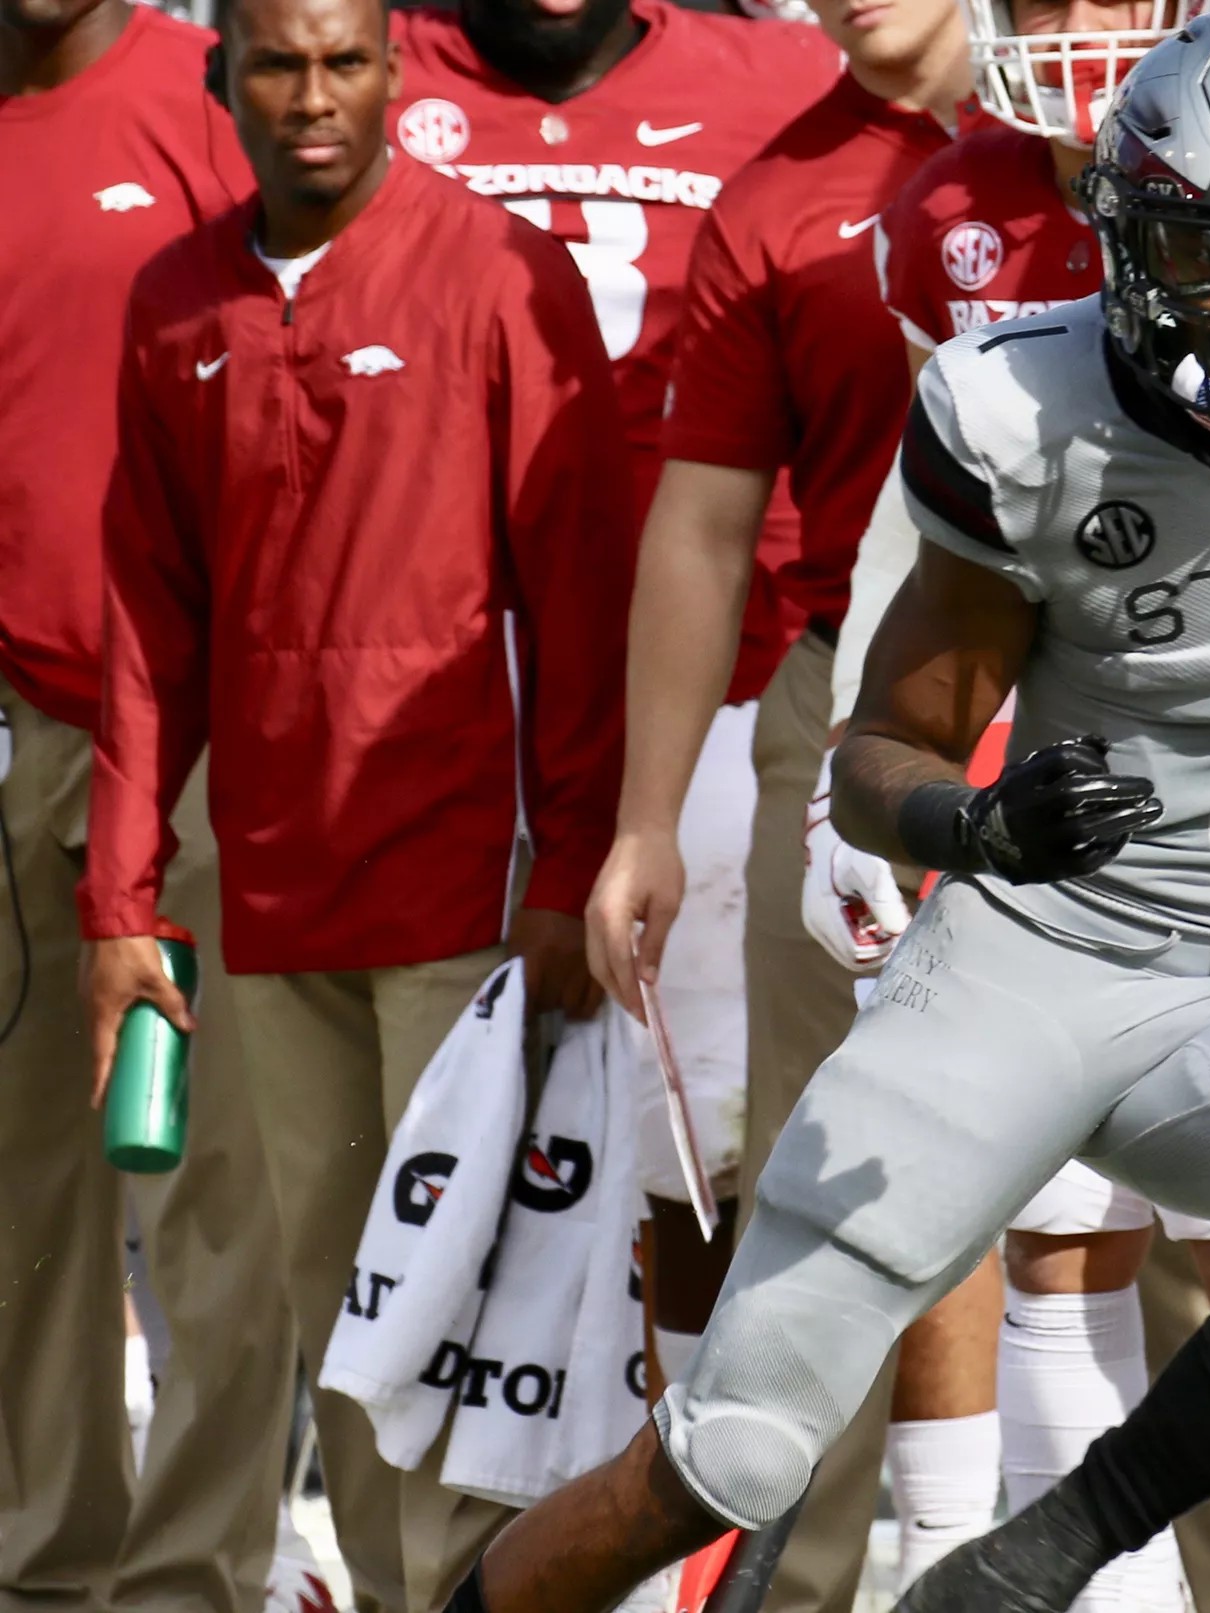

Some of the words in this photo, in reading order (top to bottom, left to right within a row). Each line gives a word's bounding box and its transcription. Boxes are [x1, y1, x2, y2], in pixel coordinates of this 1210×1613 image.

[401, 101, 466, 161] SEC
[947, 224, 1000, 288] SEC
[1079, 504, 1151, 567] SEC
